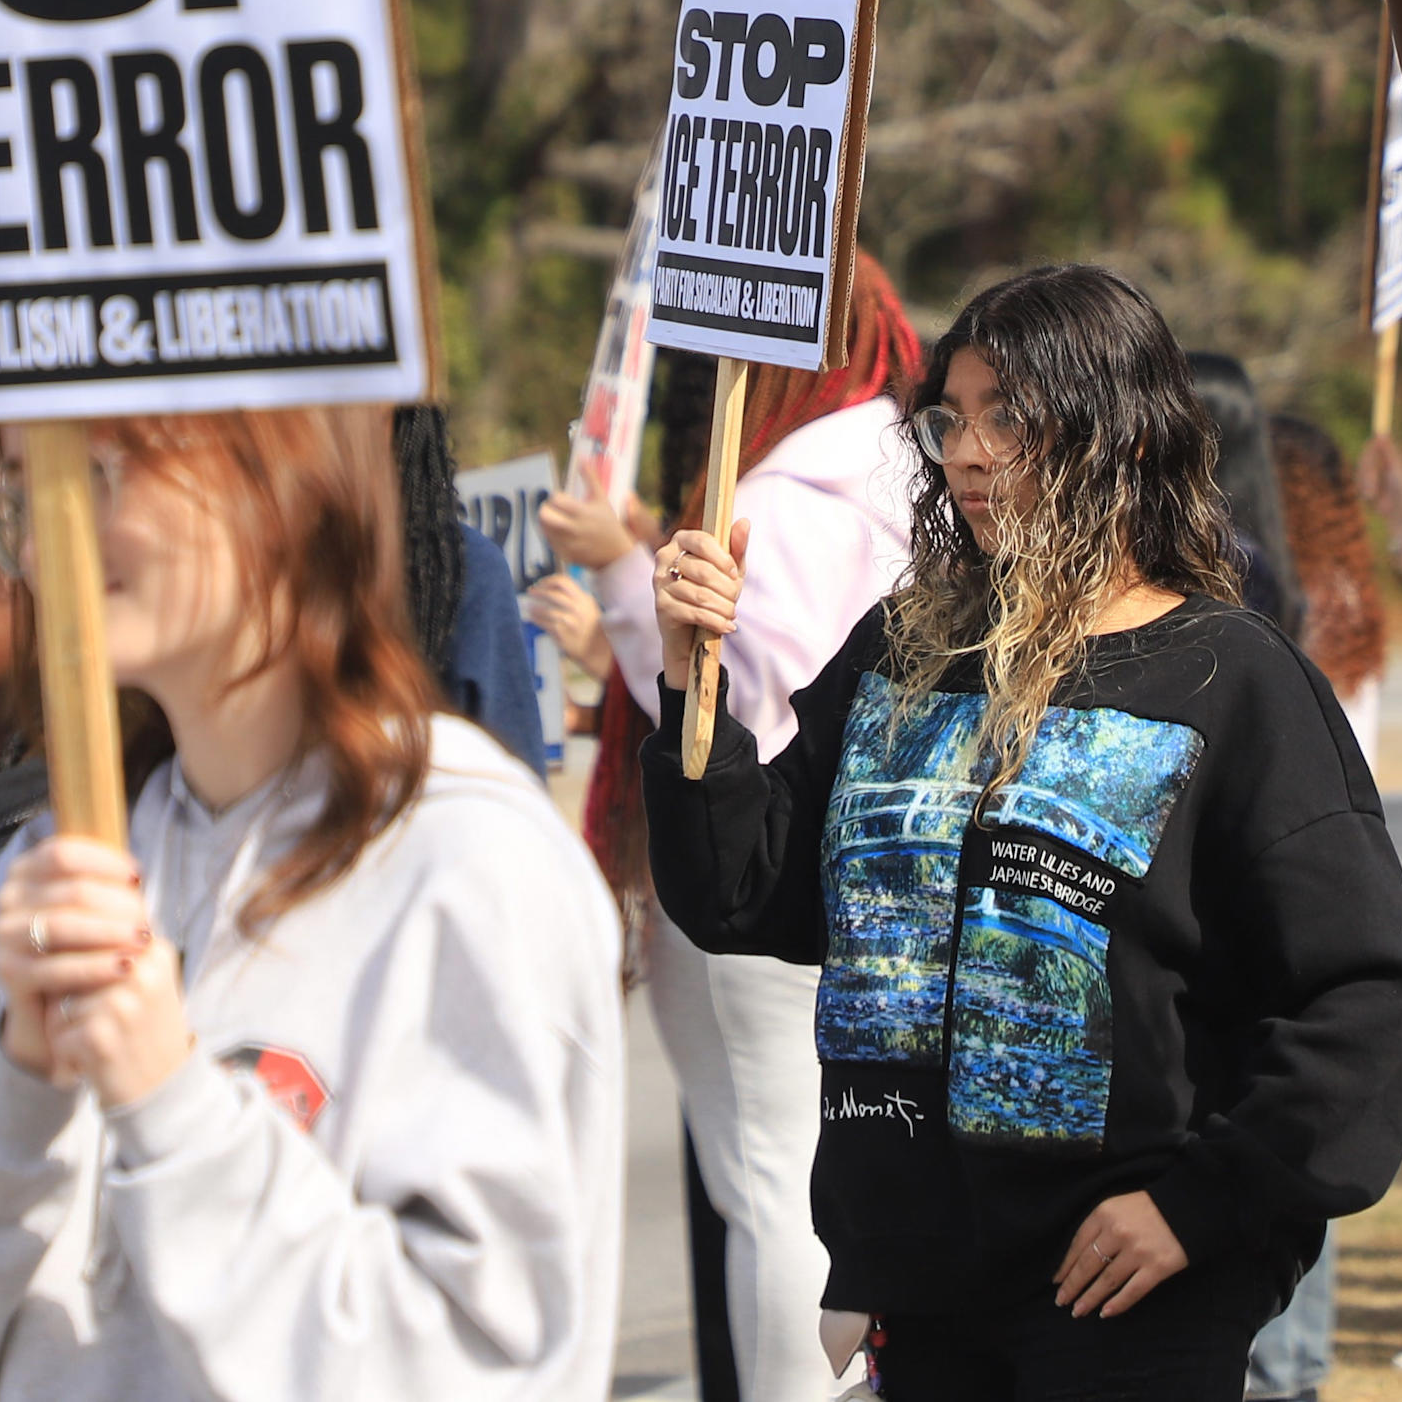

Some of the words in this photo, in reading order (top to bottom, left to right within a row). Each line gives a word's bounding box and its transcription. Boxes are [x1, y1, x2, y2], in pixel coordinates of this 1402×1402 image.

[677, 8, 845, 108] STOP
[661, 114, 705, 242] ICE
[705, 118, 833, 258] TERROR
[98, 294, 157, 366] &
[153, 277, 387, 363] LIBERATION
[655, 266, 679, 307] PARTY
[677, 270, 696, 309] FOR
[694, 272, 742, 317] SOCIALISM
[740, 280, 755, 319] &
[755, 281, 818, 328] LIBERATION
[989, 865, 1054, 894] JAPANESE
[1054, 881, 1105, 916] BRIDGE
[992, 841, 1037, 863] WATER
[1039, 850, 1082, 881] LILIES
[1079, 871, 1116, 896] AND
